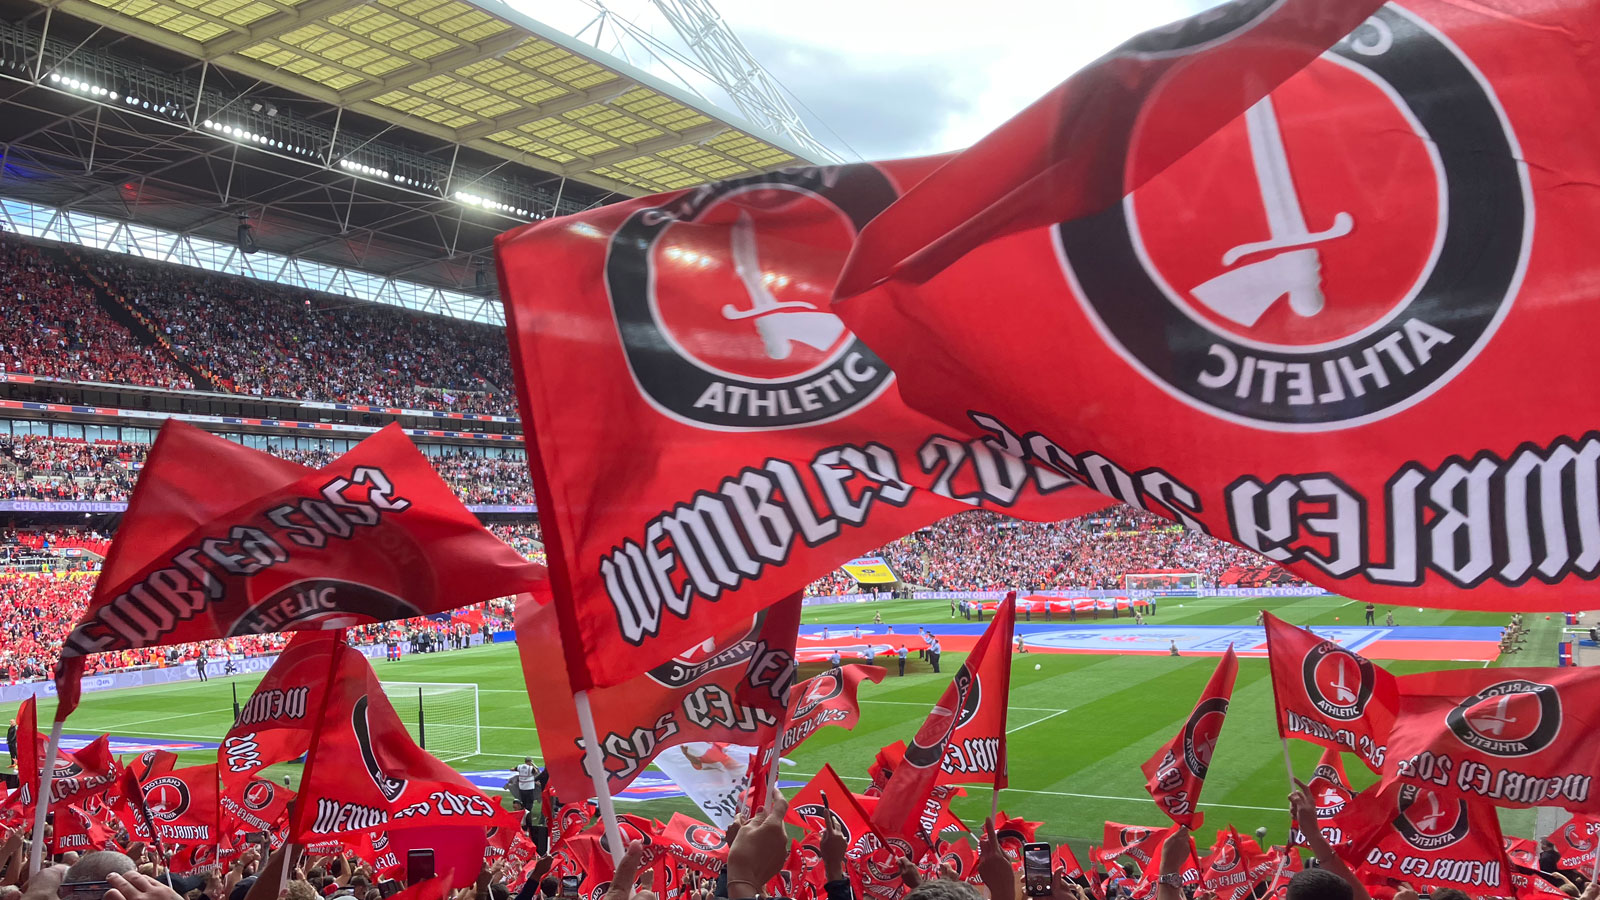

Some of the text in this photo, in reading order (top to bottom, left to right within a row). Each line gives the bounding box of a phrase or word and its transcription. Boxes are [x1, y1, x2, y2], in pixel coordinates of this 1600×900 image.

[693, 351, 877, 418] ATHLETIC
[12, 502, 79, 510] CHARLTON
[599, 442, 913, 645] WEMBLEY
[1260, 588, 1302, 596] LEYTON
[1318, 700, 1359, 717] ATHLETIC
[225, 733, 262, 773] 2025
[1186, 738, 1203, 773] ATHLETIC
[429, 790, 495, 818] 2025
